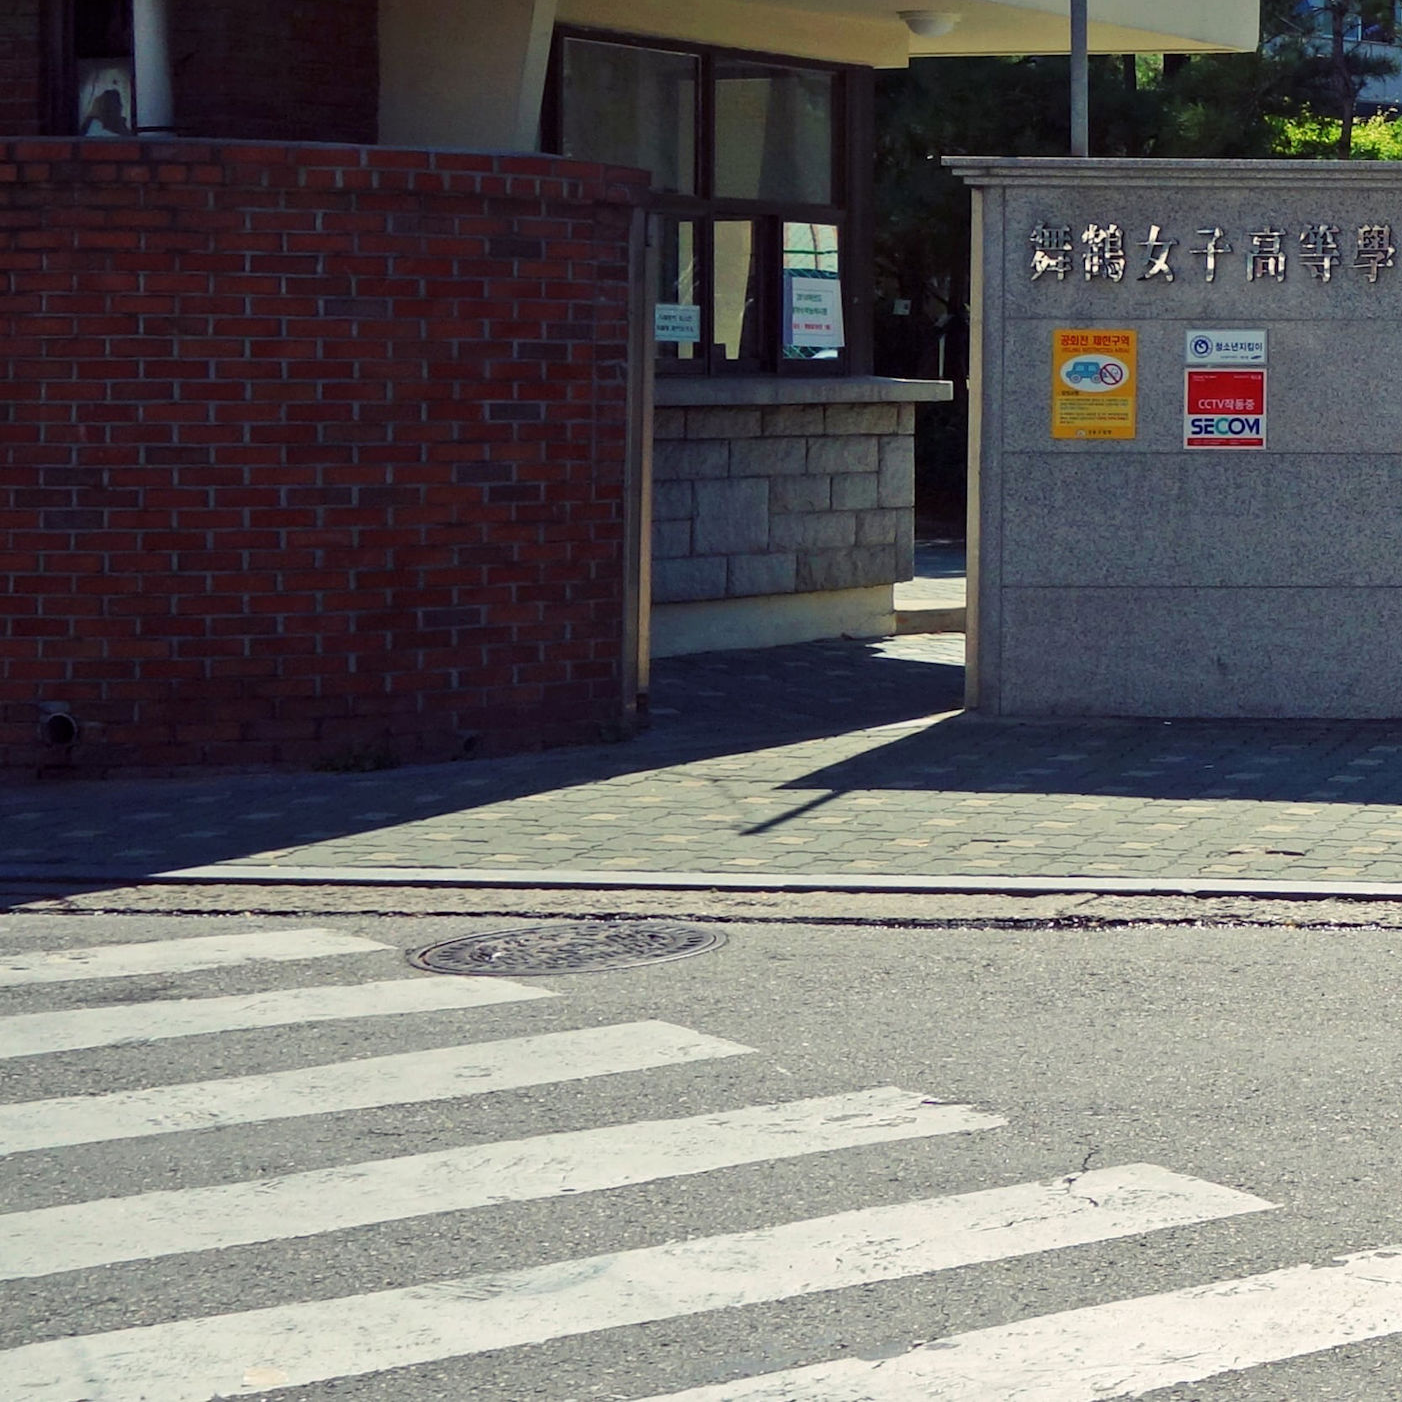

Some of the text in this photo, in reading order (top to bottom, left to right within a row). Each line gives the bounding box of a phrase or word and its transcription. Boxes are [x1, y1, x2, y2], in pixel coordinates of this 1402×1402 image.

[1216, 342, 1262, 352] 청소년지킴이
[1198, 399, 1255, 410] CCTV작동중
[1191, 417, 1260, 435] SECOM
